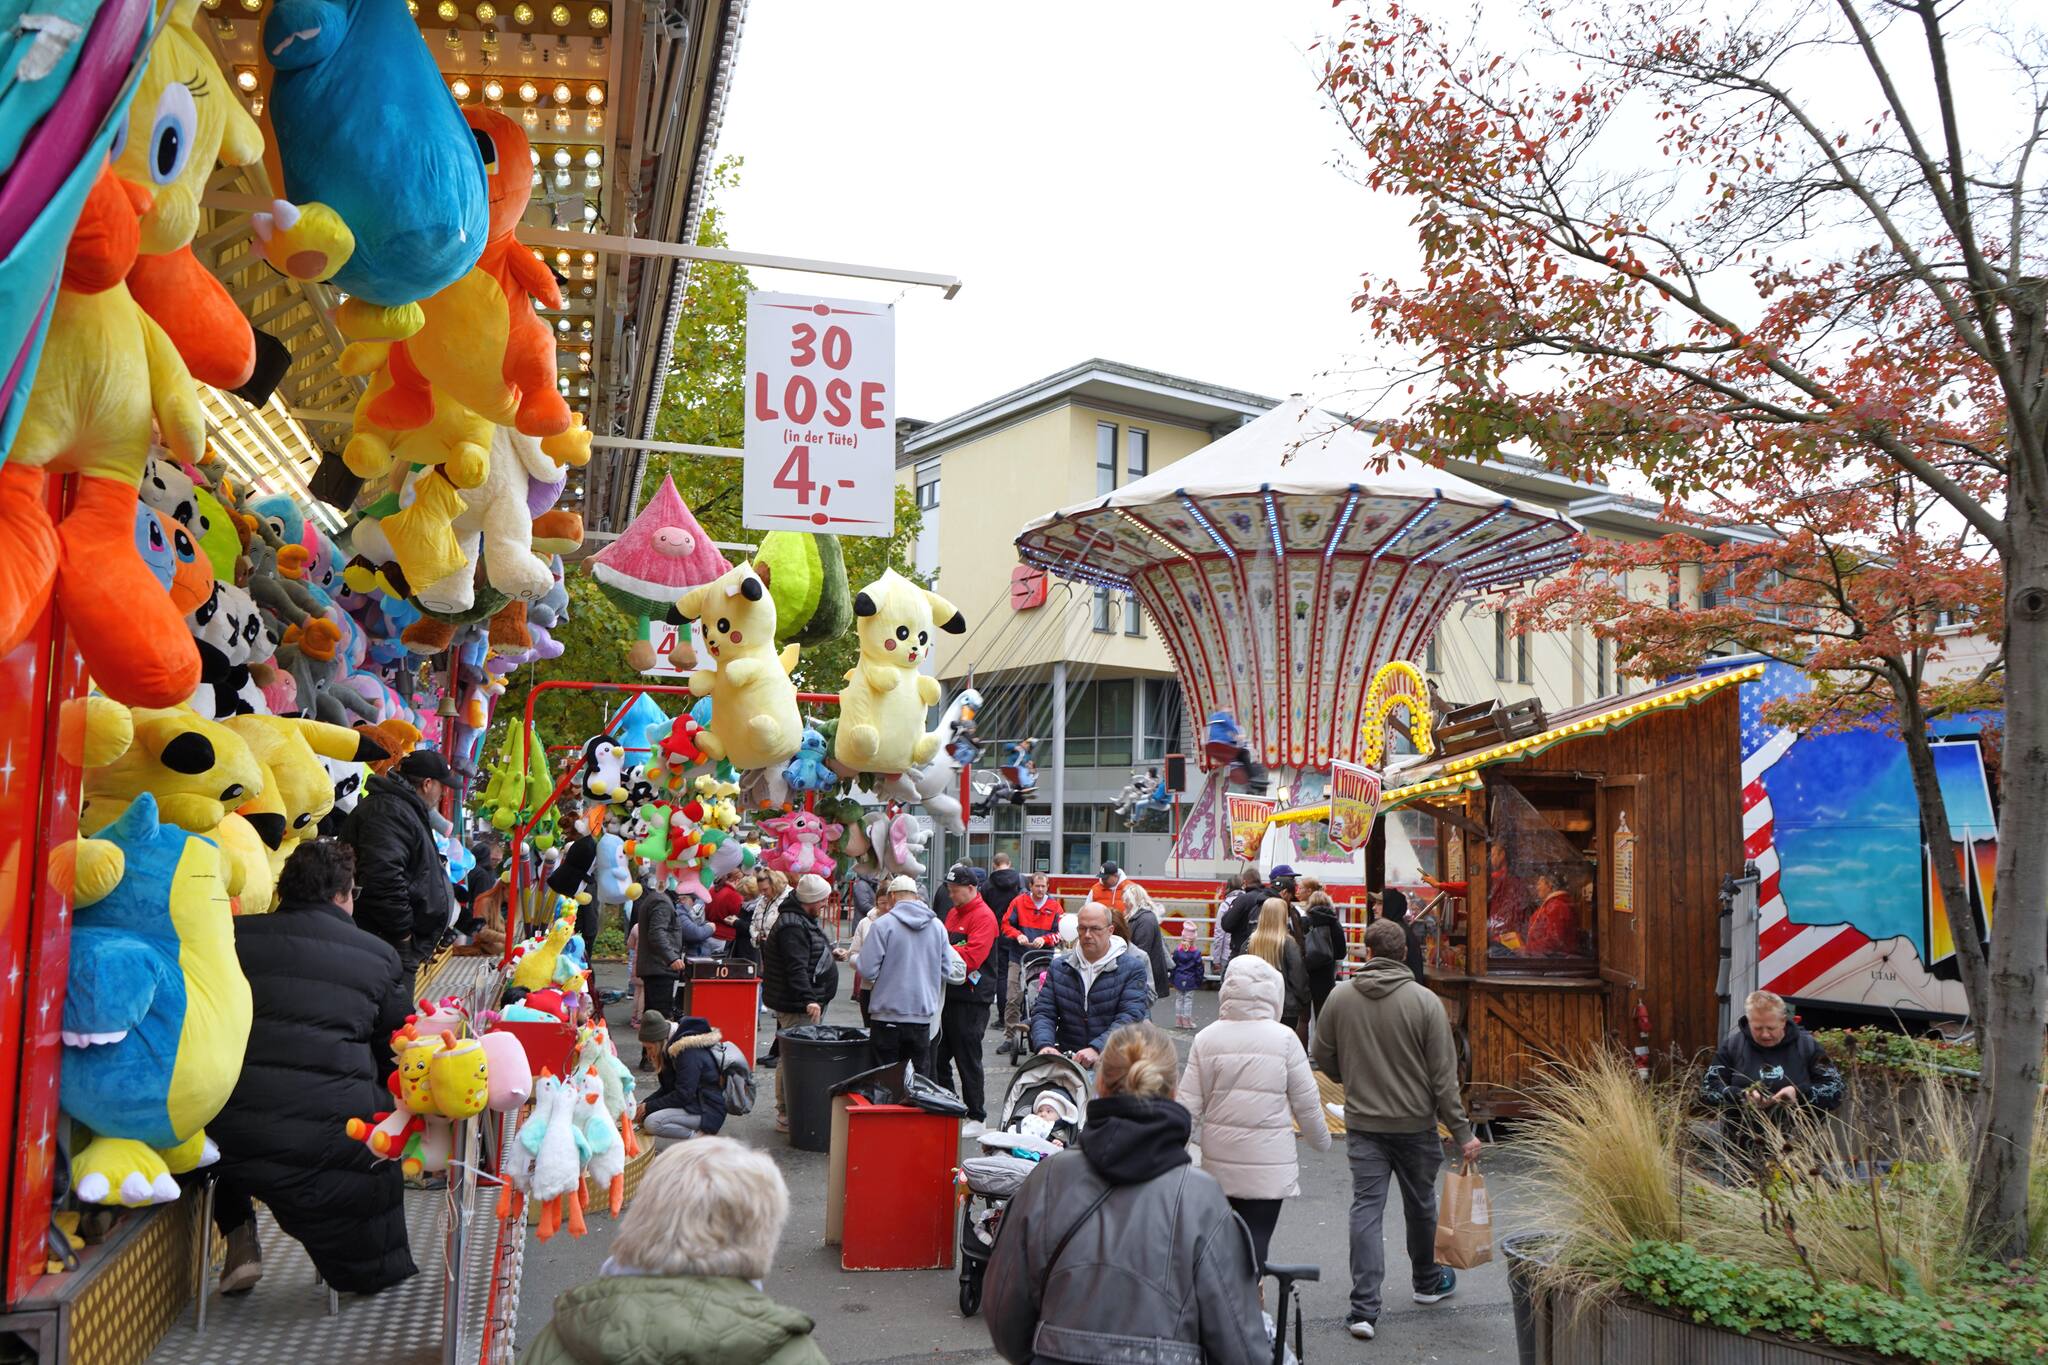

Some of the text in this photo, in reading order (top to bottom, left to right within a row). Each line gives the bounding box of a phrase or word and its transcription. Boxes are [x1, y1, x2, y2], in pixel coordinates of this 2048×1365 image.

[790, 322, 852, 371] 30
[755, 372, 886, 429] LOSE
[784, 429, 857, 449] (in der Tüte)
[773, 445, 855, 506] 4,-
[1334, 768, 1378, 807] Churros
[716, 966, 728, 978] 10
[1871, 970, 1896, 981] UTAH
